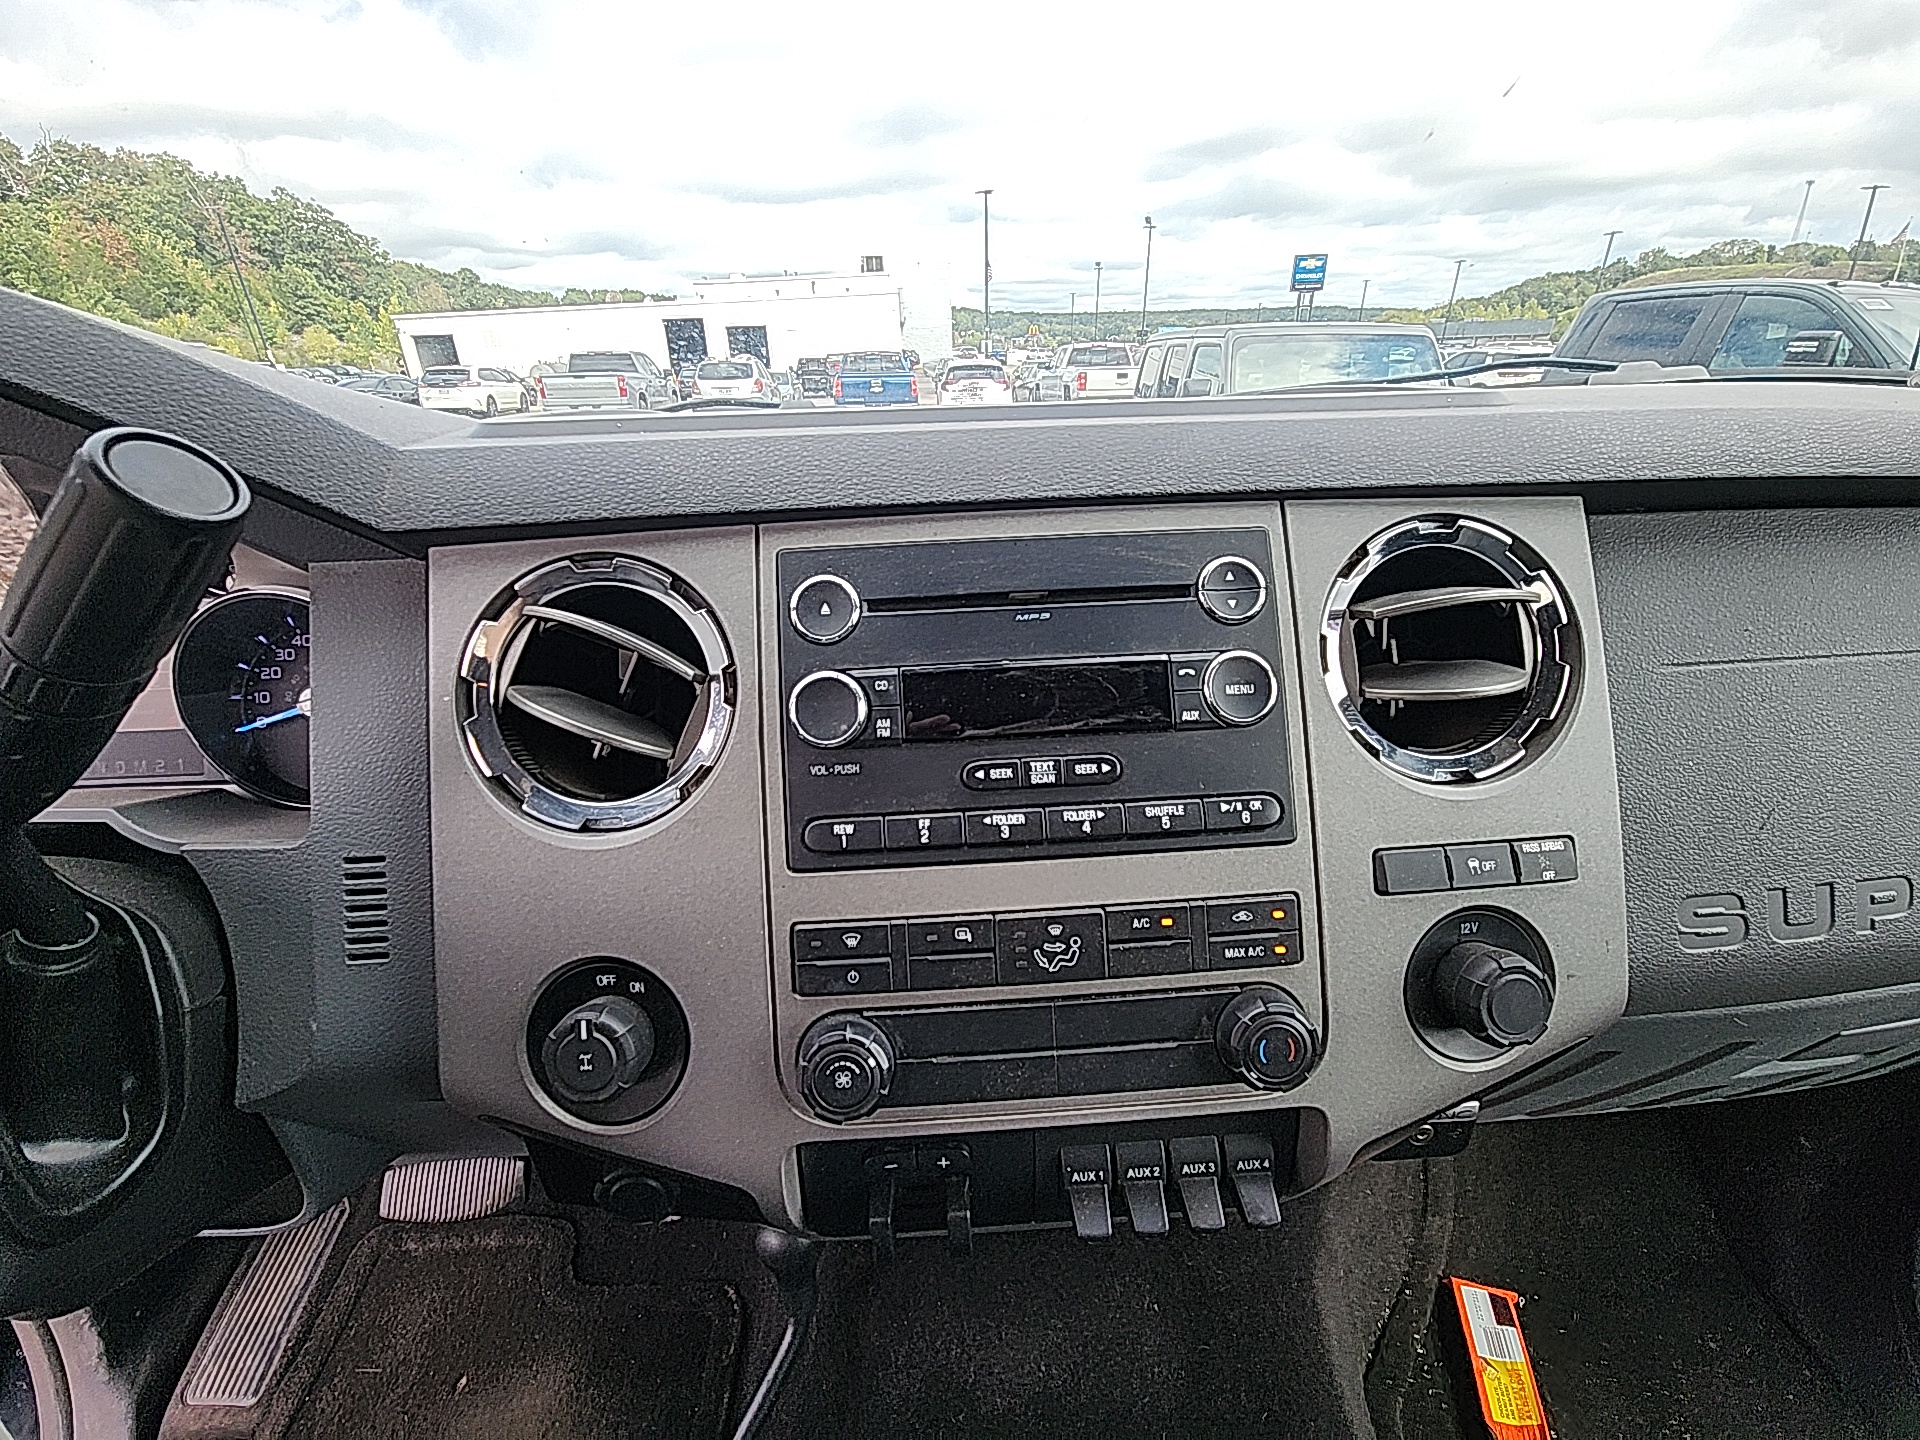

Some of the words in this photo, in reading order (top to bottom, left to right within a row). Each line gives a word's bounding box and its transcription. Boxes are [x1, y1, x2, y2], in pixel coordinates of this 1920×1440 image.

[1014, 612, 1051, 621] MP3
[291, 634, 311, 647] 40
[275, 648, 296, 661] 30
[260, 666, 282, 680] 20
[874, 680, 889, 692] CD
[1225, 683, 1255, 696] MENU
[253, 691, 271, 704] 10
[1181, 710, 1200, 722] AUX
[876, 718, 891, 729] AM
[876, 728, 891, 739] FM
[1029, 761, 1055, 773] TEXT
[1075, 763, 1098, 776] SEEK
[989, 768, 1013, 780] SEEK
[1030, 772, 1056, 785] SCAN
[1063, 810, 1097, 822] FOLDER
[1145, 805, 1185, 818] SHUFFLE
[1241, 811, 1251, 824] 6
[919, 819, 931, 830] FF
[992, 813, 1026, 826] FOLDER
[1161, 816, 1170, 829] 5
[833, 824, 855, 836] REW
[1000, 825, 1010, 839] 3
[1081, 821, 1092, 834] 4
[840, 835, 847, 849] 1
[920, 829, 930, 844] 2
[1481, 860, 1497, 872] OFF
[1542, 871, 1556, 880] OFF
[1678, 875, 1912, 953] SUP
[1132, 916, 1151, 929] A/C
[1460, 920, 1479, 934] 12V
[1224, 945, 1245, 959] MAX
[1246, 944, 1266, 958] A/C
[596, 974, 617, 986] OFF
[629, 982, 645, 993] ON
[1182, 1162, 1205, 1175] AUX
[1206, 1161, 1216, 1174] 3
[1237, 1159, 1260, 1172] AUX
[1261, 1158, 1271, 1171] 4
[1072, 1170, 1095, 1184] AUX
[1097, 1169, 1104, 1183] 1
[1127, 1166, 1150, 1179] AUX
[1151, 1165, 1161, 1178] 2
